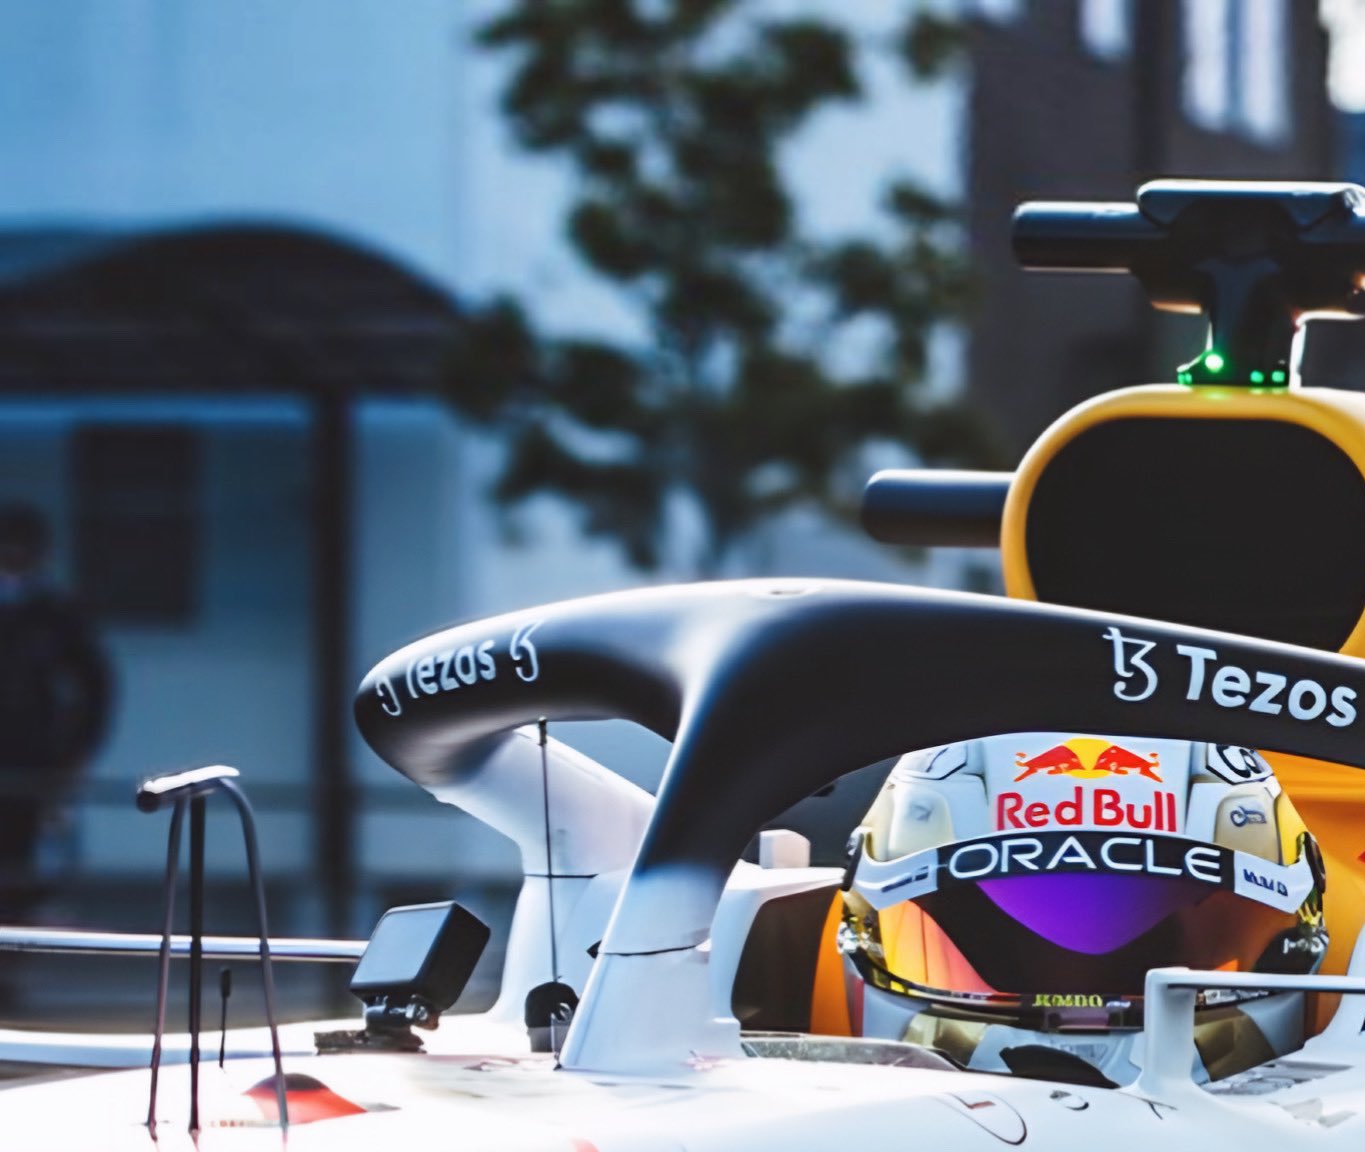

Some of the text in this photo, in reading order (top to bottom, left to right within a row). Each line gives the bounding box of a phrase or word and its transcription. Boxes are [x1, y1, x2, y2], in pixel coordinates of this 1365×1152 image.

[1176, 644, 1357, 727] Tezos
[997, 786, 1177, 832] Red Bull
[948, 835, 1222, 884] ORACLE
